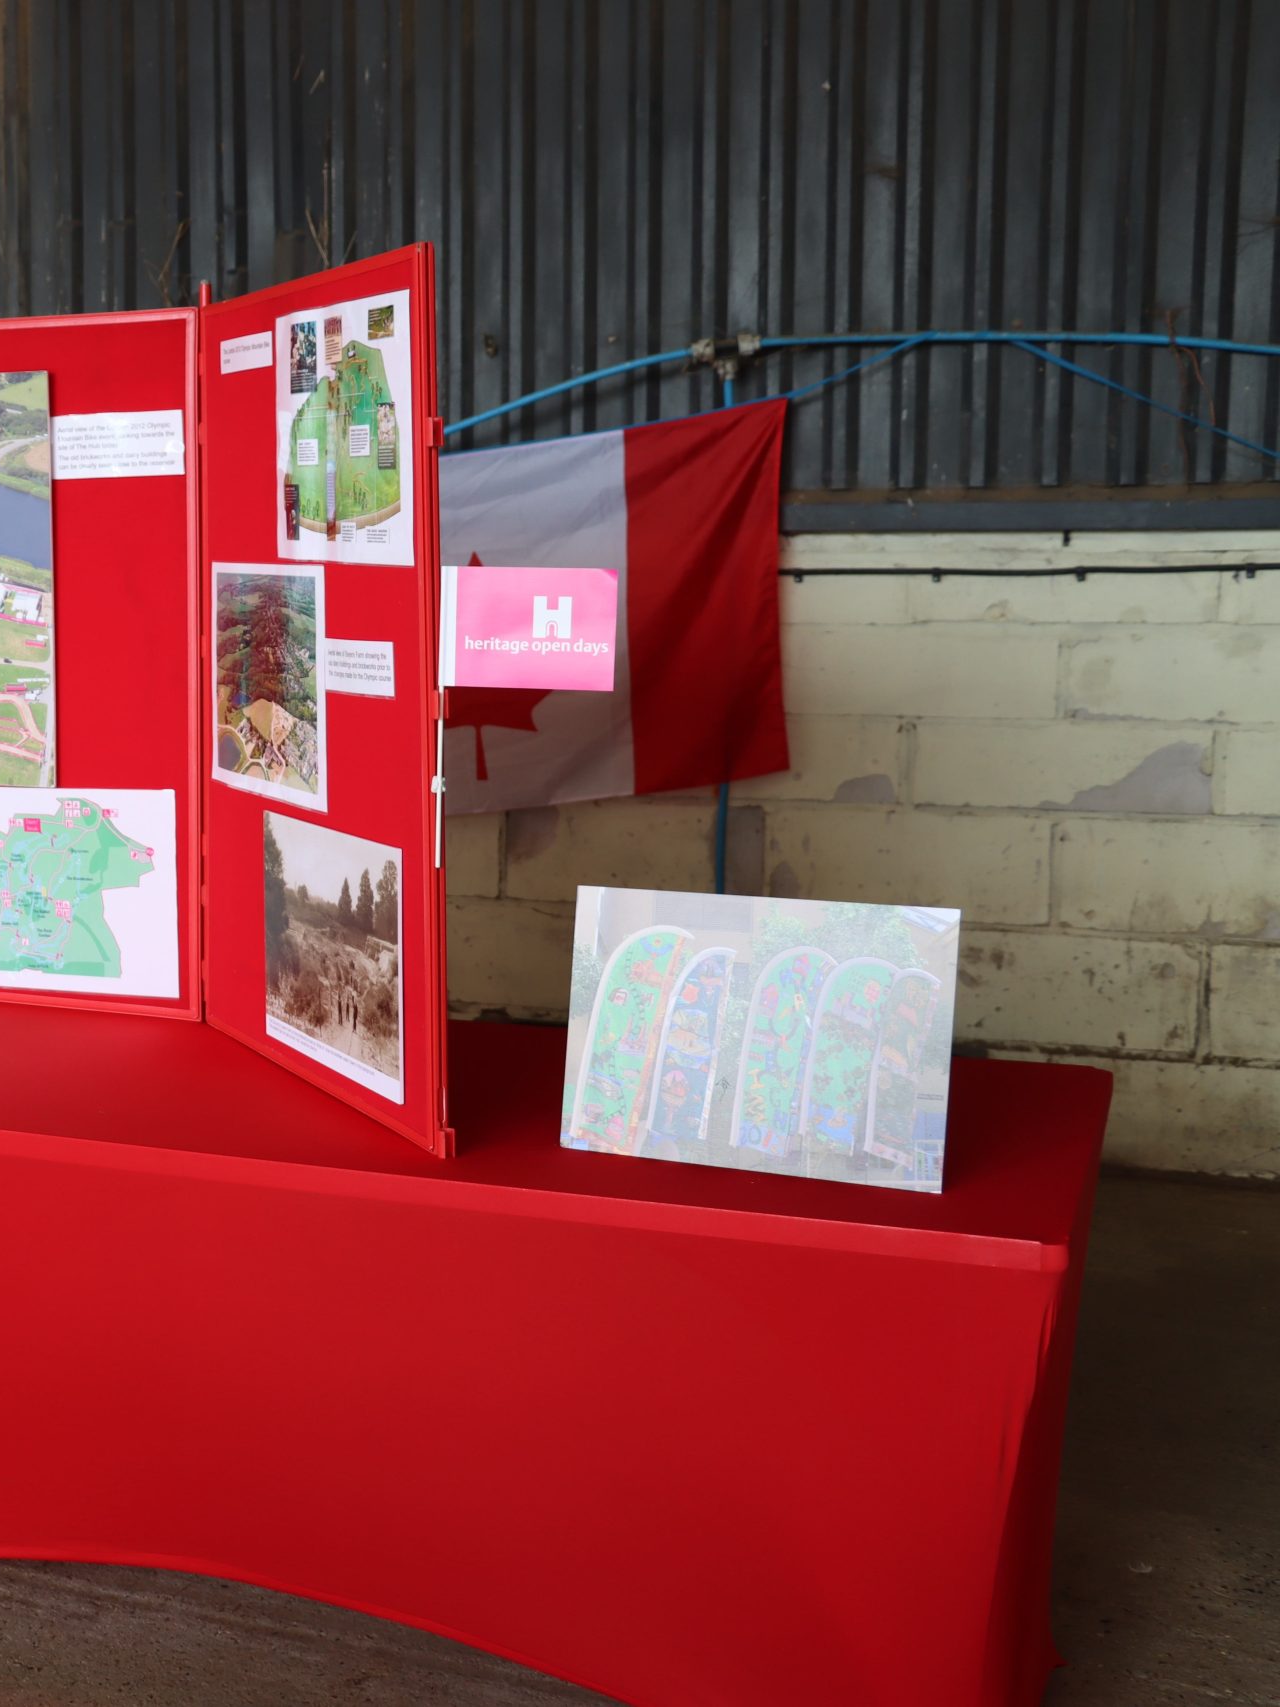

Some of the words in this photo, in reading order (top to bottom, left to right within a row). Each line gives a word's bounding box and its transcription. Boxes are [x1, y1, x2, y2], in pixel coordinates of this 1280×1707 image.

[146, 422, 171, 430] Olympic
[141, 431, 164, 439] towards
[141, 451, 167, 459] buildings
[464, 635, 529, 654] heritage
[531, 641, 571, 655] open
[573, 638, 609, 656] days
